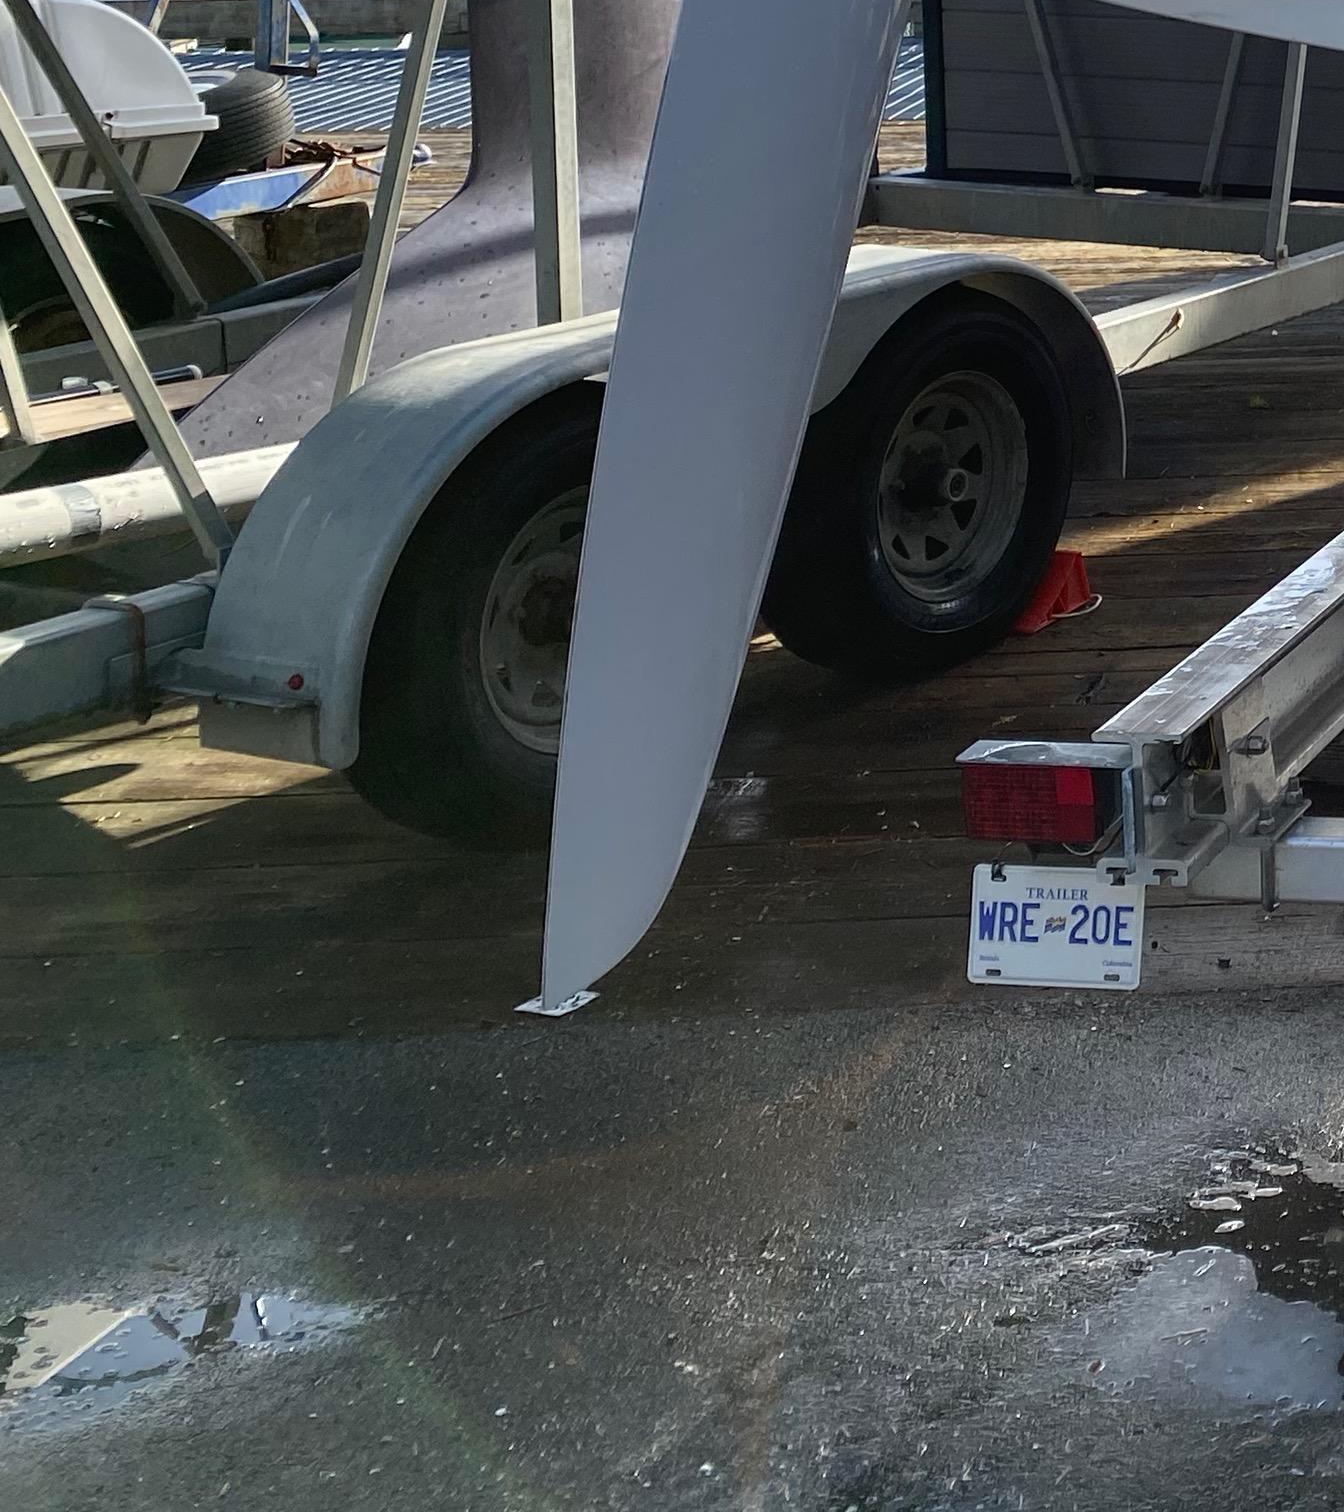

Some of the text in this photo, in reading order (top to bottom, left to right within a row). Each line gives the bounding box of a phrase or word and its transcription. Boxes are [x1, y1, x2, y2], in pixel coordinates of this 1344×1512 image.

[1026, 887, 1089, 901] TRAILER
[978, 900, 1135, 947] WRE 20E
